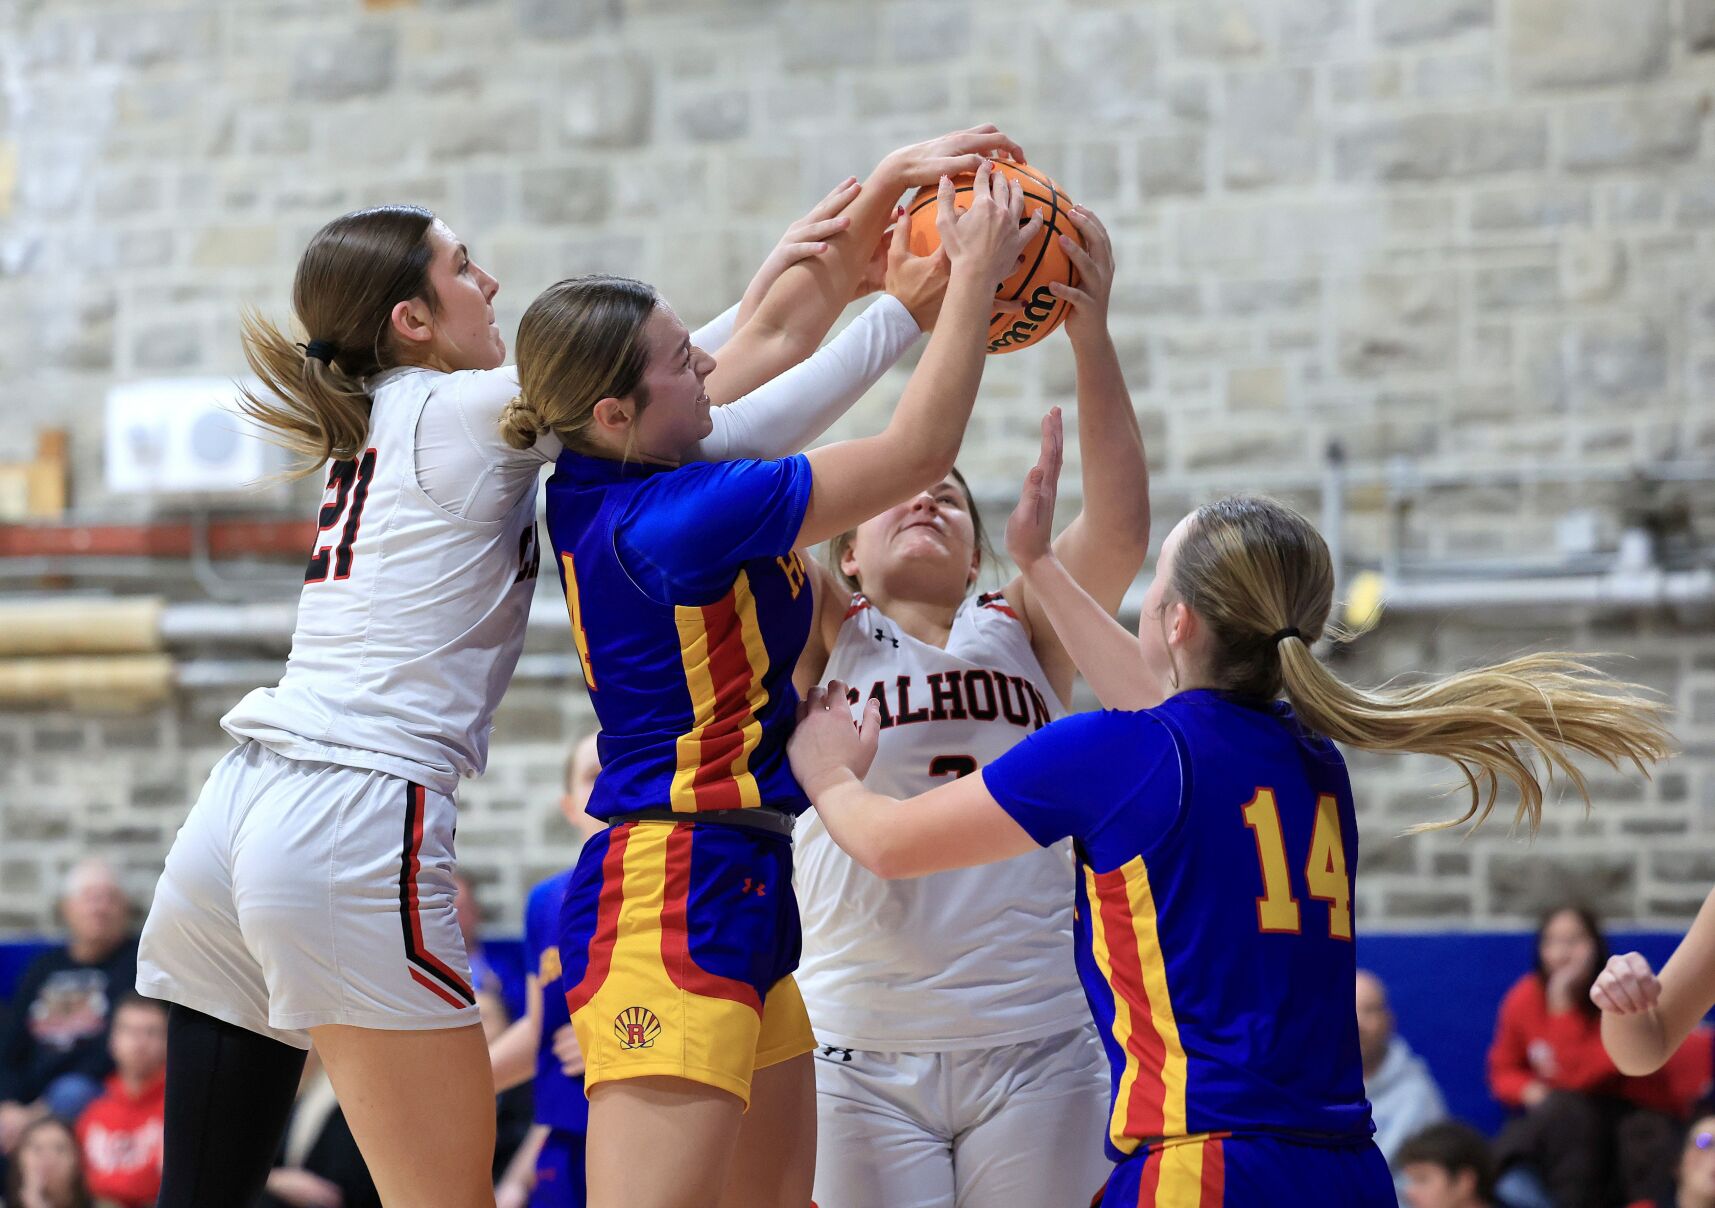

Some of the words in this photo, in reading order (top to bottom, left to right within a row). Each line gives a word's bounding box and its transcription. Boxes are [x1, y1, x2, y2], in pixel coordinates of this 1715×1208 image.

[986, 285, 1057, 352] Wils
[304, 447, 377, 584] 21
[776, 550, 805, 600] H
[1240, 786, 1352, 942] 14
[627, 1023, 646, 1045] R
